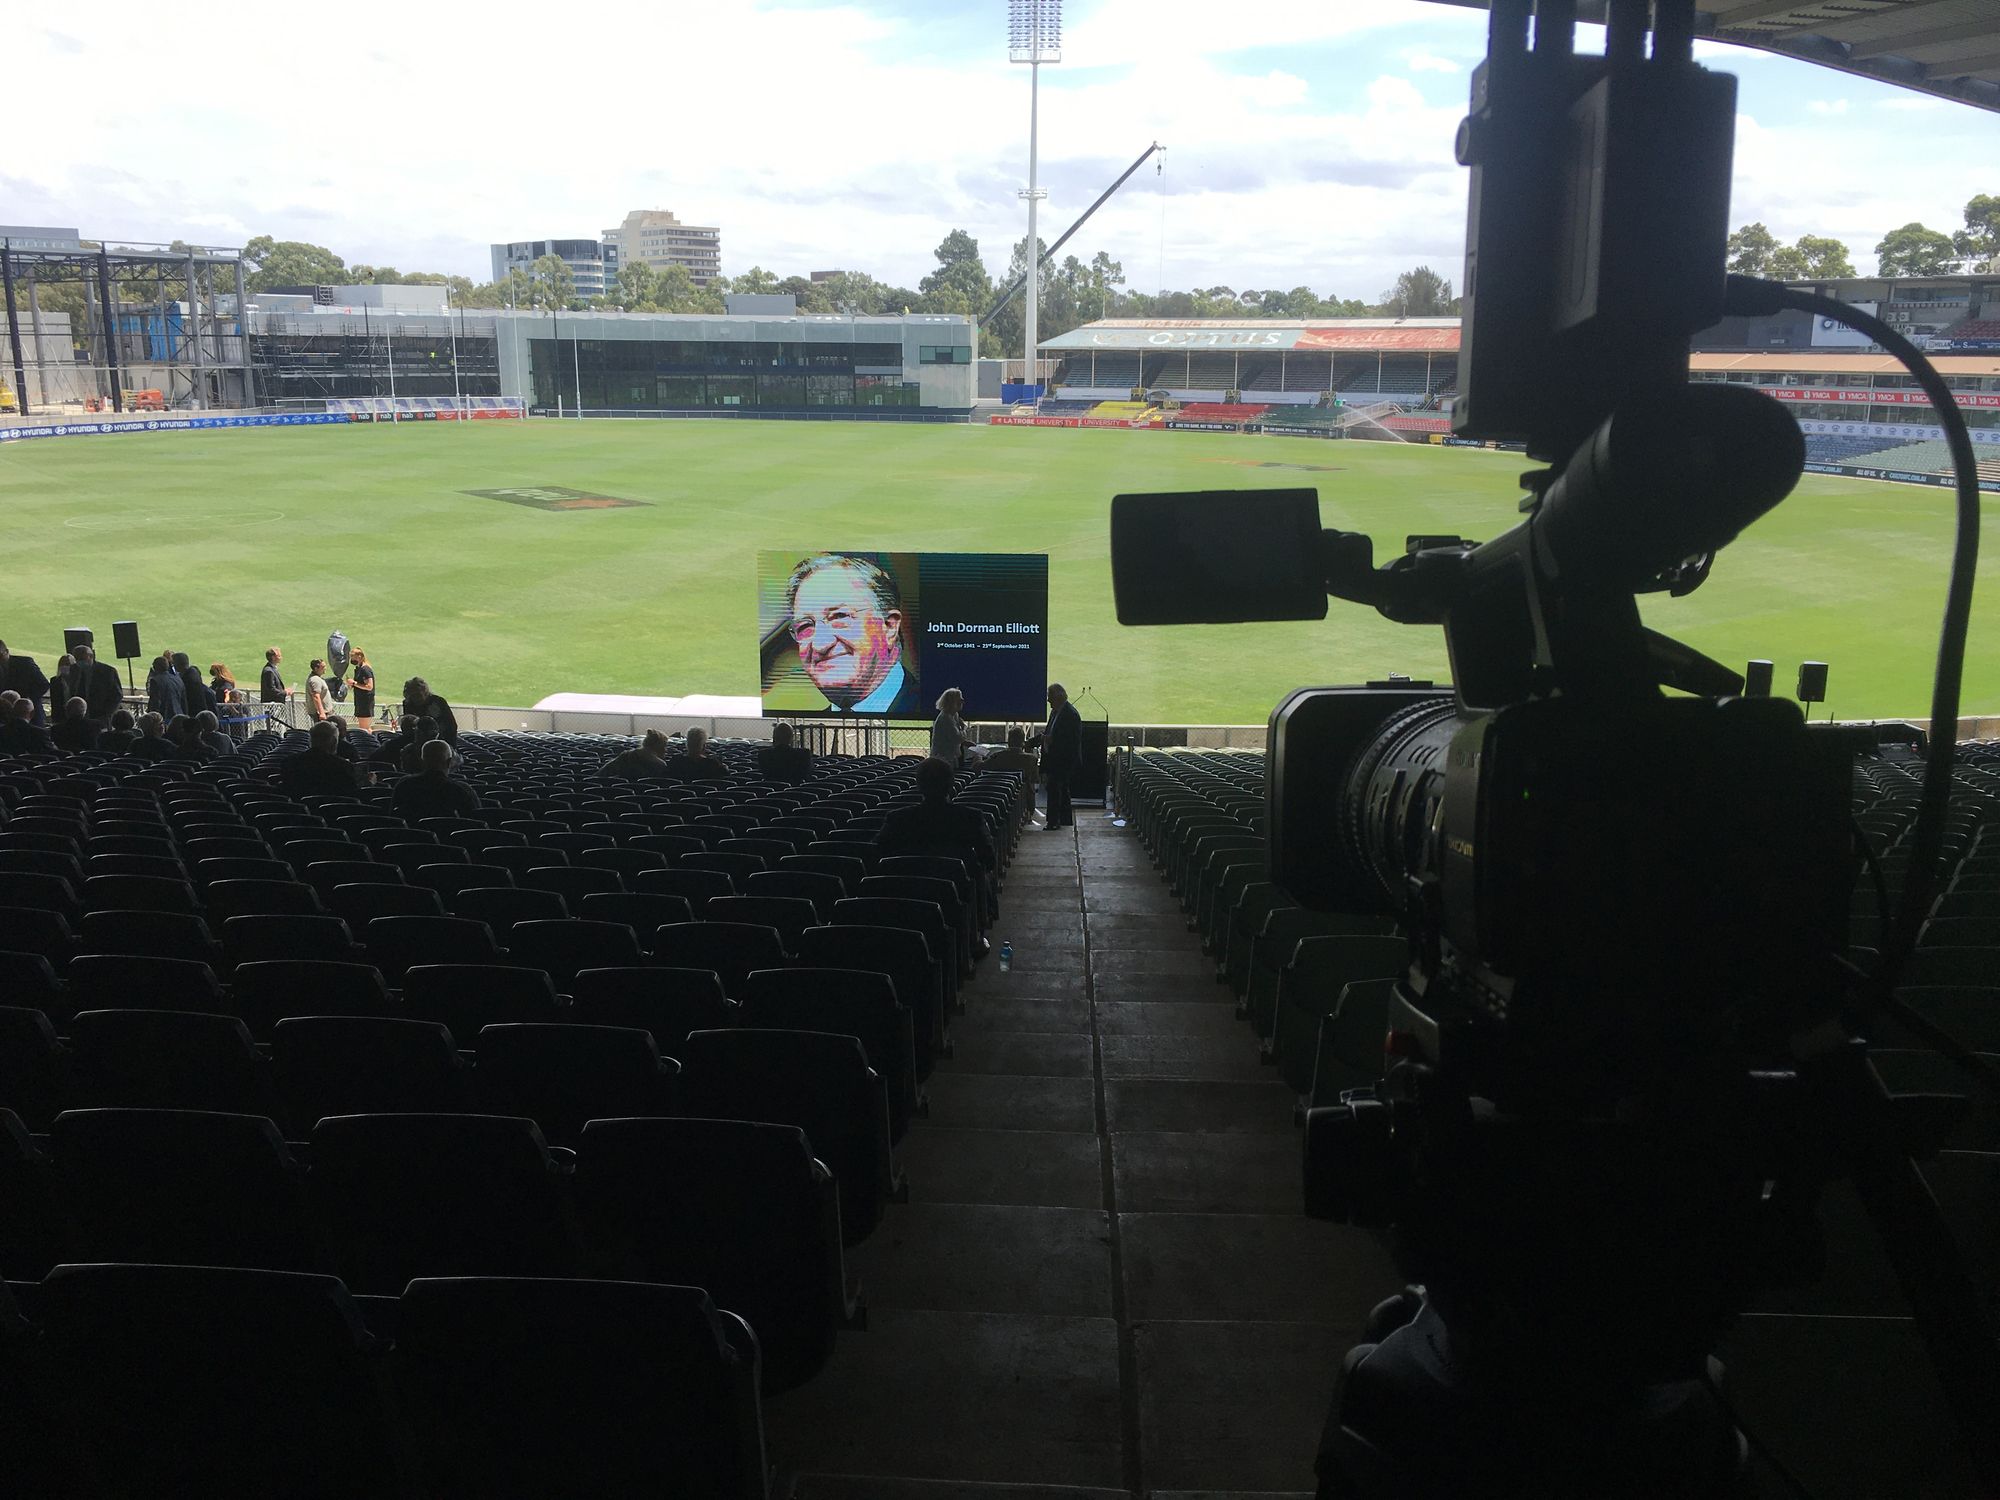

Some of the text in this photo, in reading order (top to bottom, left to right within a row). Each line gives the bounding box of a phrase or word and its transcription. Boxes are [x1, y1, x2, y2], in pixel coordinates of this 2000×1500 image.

[160, 420, 190, 428] HYUNDAI
[1037, 418, 1074, 426] UNIVERSTY
[114, 423, 144, 431] HYUNDAI
[22, 428, 52, 436] HYUNDAI
[927, 622, 1040, 634] John Dorman Elliott
